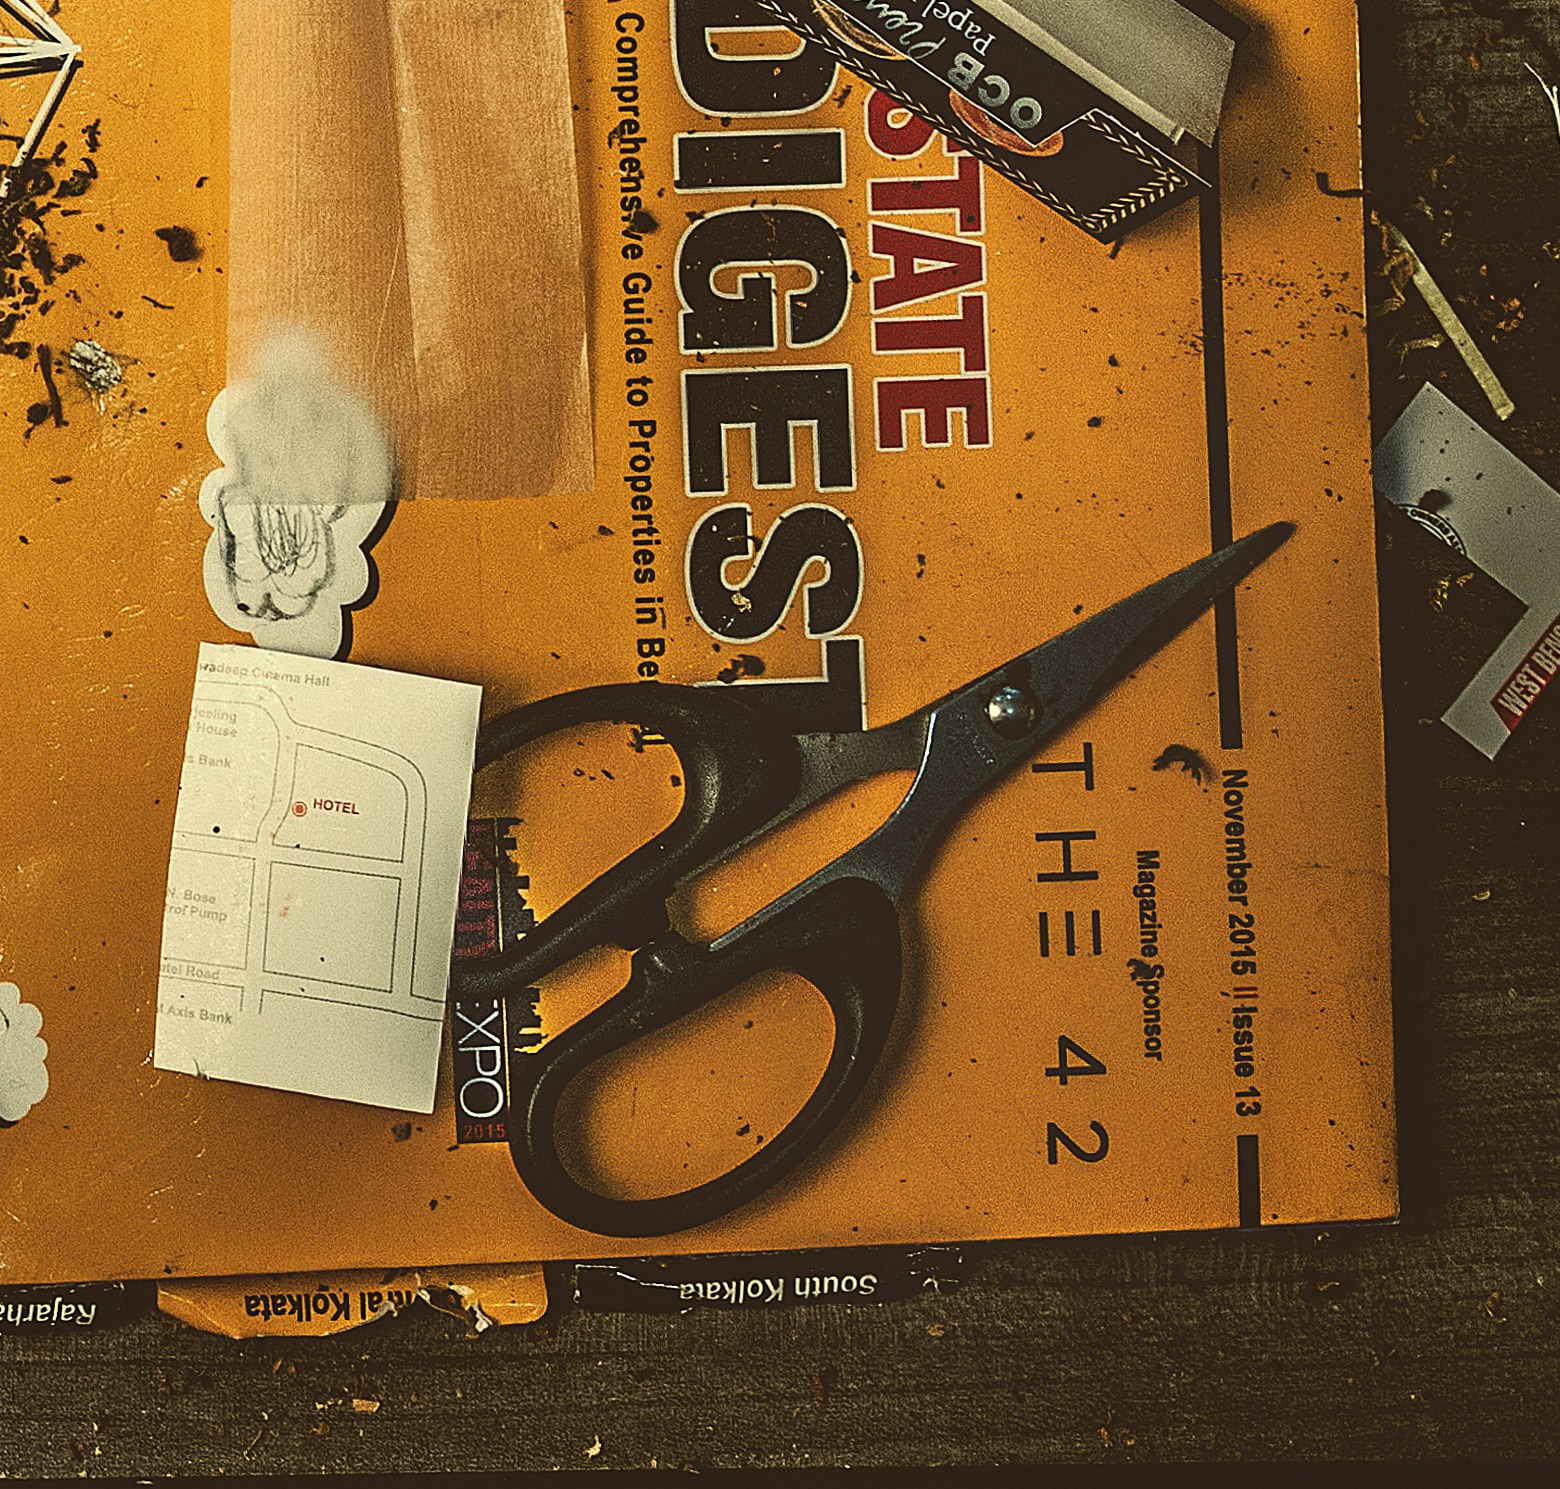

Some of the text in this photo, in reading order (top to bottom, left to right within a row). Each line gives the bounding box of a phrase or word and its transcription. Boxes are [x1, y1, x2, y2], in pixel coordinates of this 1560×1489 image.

[948, 51, 1043, 128] OCB
[612, 12, 646, 260] Comprehensive
[865, 92, 992, 454] STATE
[621, 271, 651, 364] Guide
[626, 373, 652, 406] to
[626, 417, 657, 590] Properties
[635, 596, 660, 625] in
[1498, 663, 1548, 718] WEST
[312, 797, 360, 815] HOTEL
[1221, 769, 1253, 910] November
[1135, 849, 1163, 959] Magazine
[1031, 743, 1110, 1166] THE 42
[1228, 914, 1254, 975] 2015
[199, 1008, 233, 1025] Bank
[1230, 1006, 1256, 1075] Issue
[1235, 1085, 1260, 1116] 13
[463, 1124, 506, 1140] 2015
[245, 1291, 352, 1322] Kolkata
[680, 1275, 878, 1303] South Kolkata
